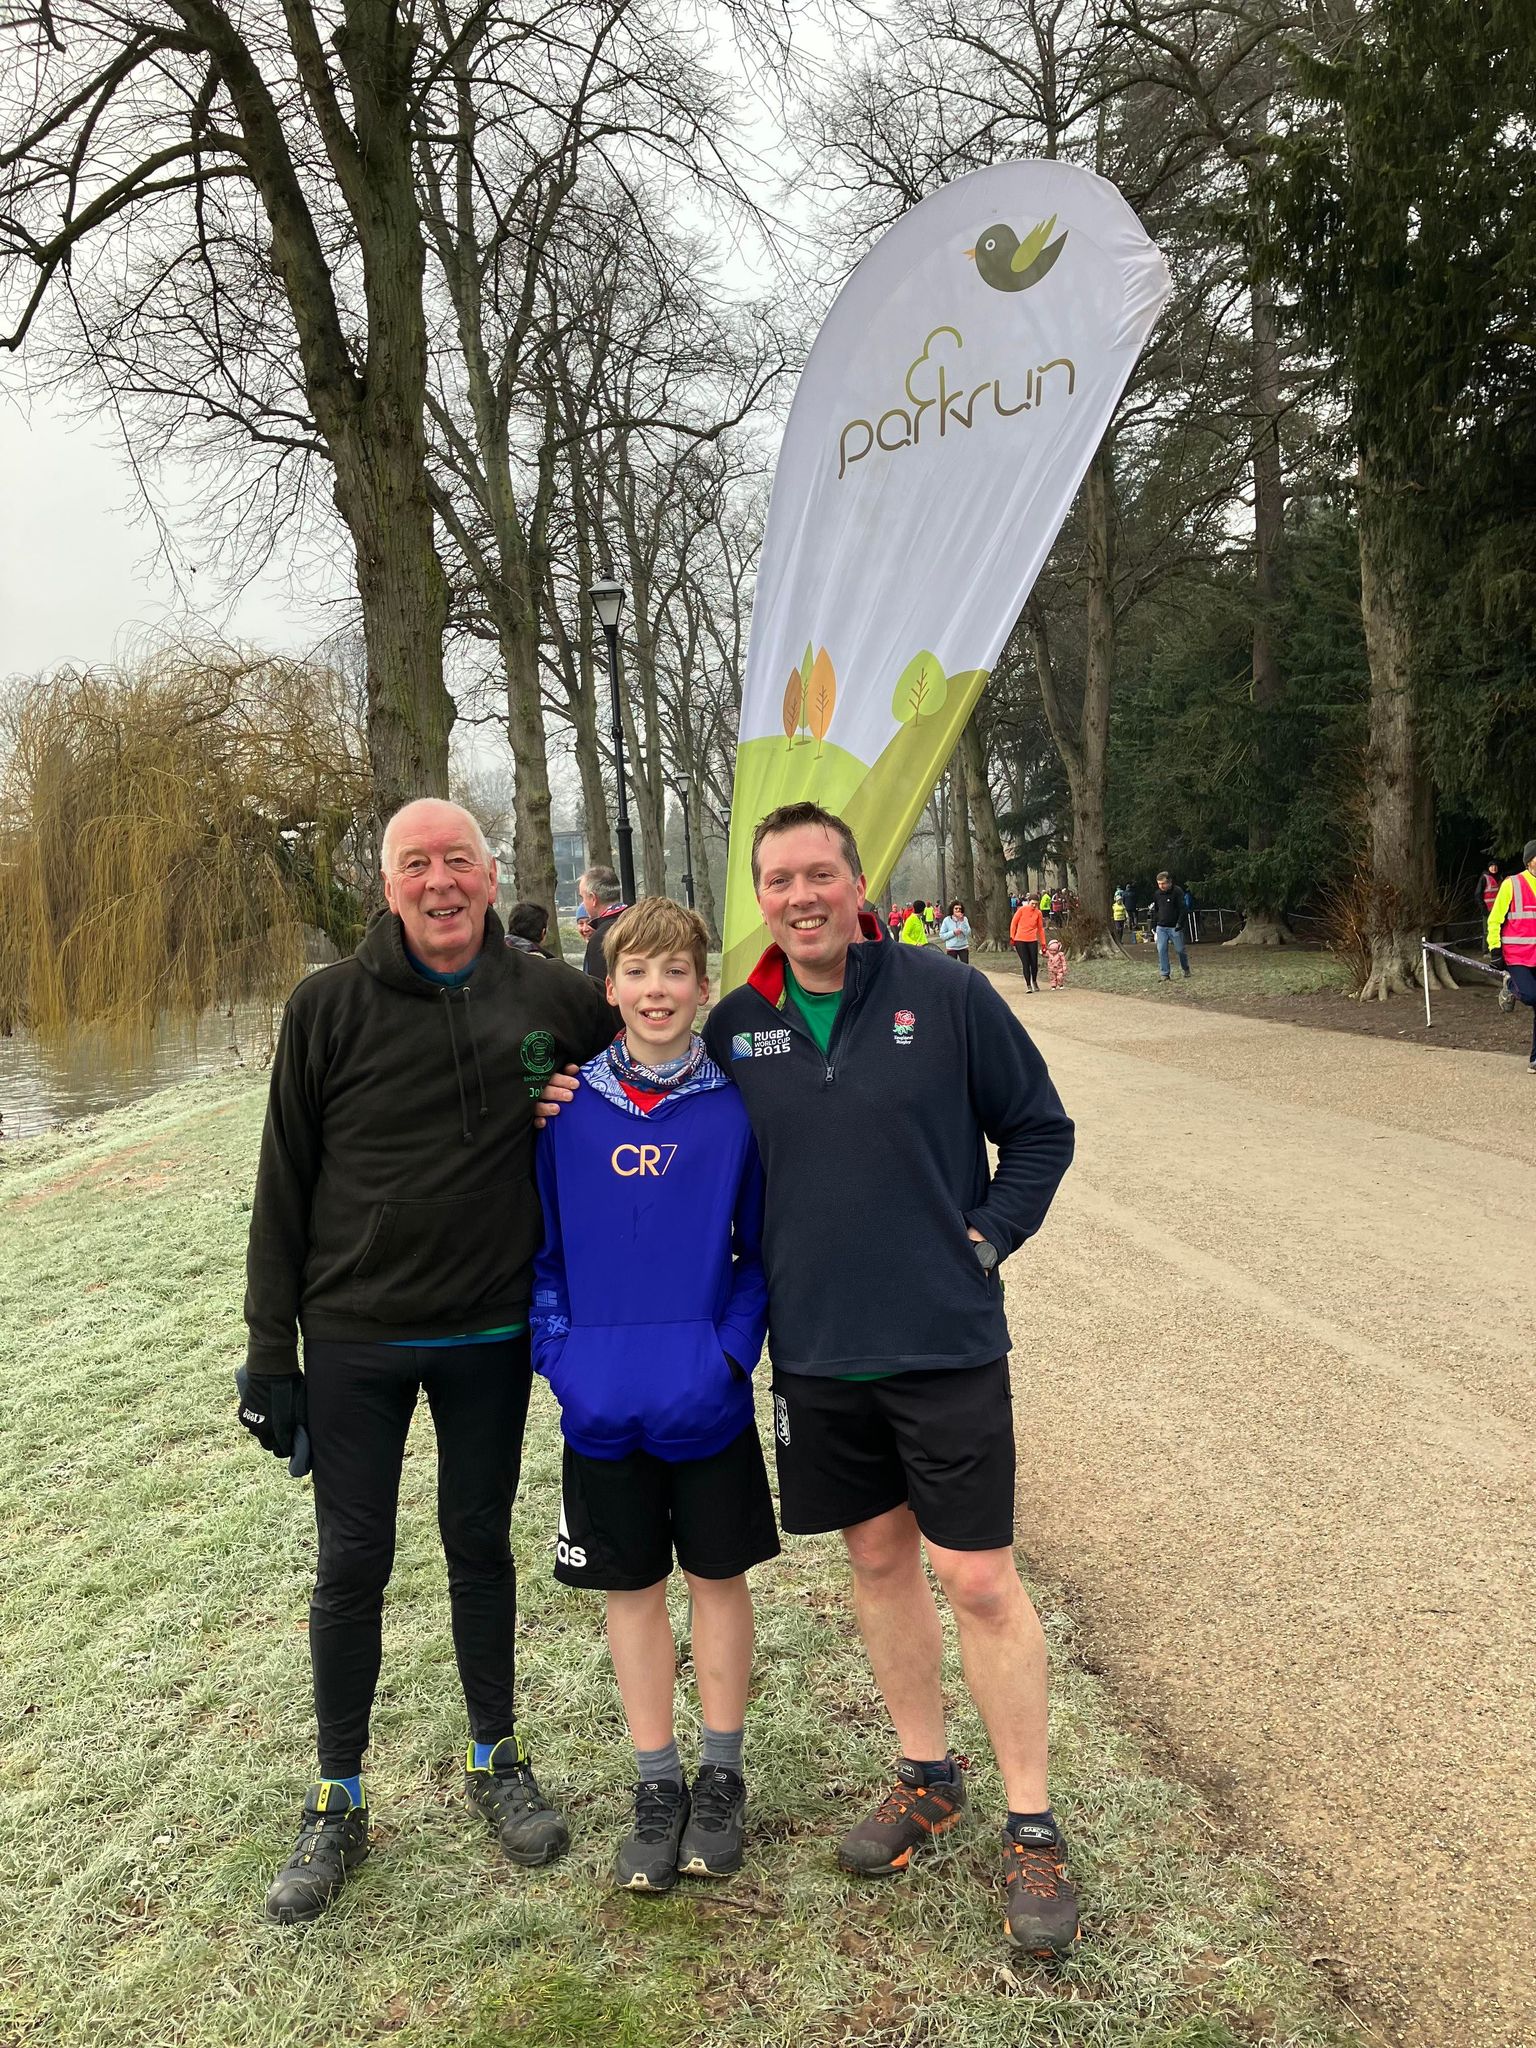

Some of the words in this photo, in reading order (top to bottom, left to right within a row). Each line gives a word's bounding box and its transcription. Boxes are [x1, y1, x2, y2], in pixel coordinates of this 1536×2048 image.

[838, 326, 1076, 480] parkrun
[754, 1029, 791, 1041] RUGBY
[754, 1040, 777, 1048] WORLD
[777, 1037, 791, 1045] CUP
[754, 1043, 791, 1057] 2015
[611, 1143, 678, 1176] CR7
